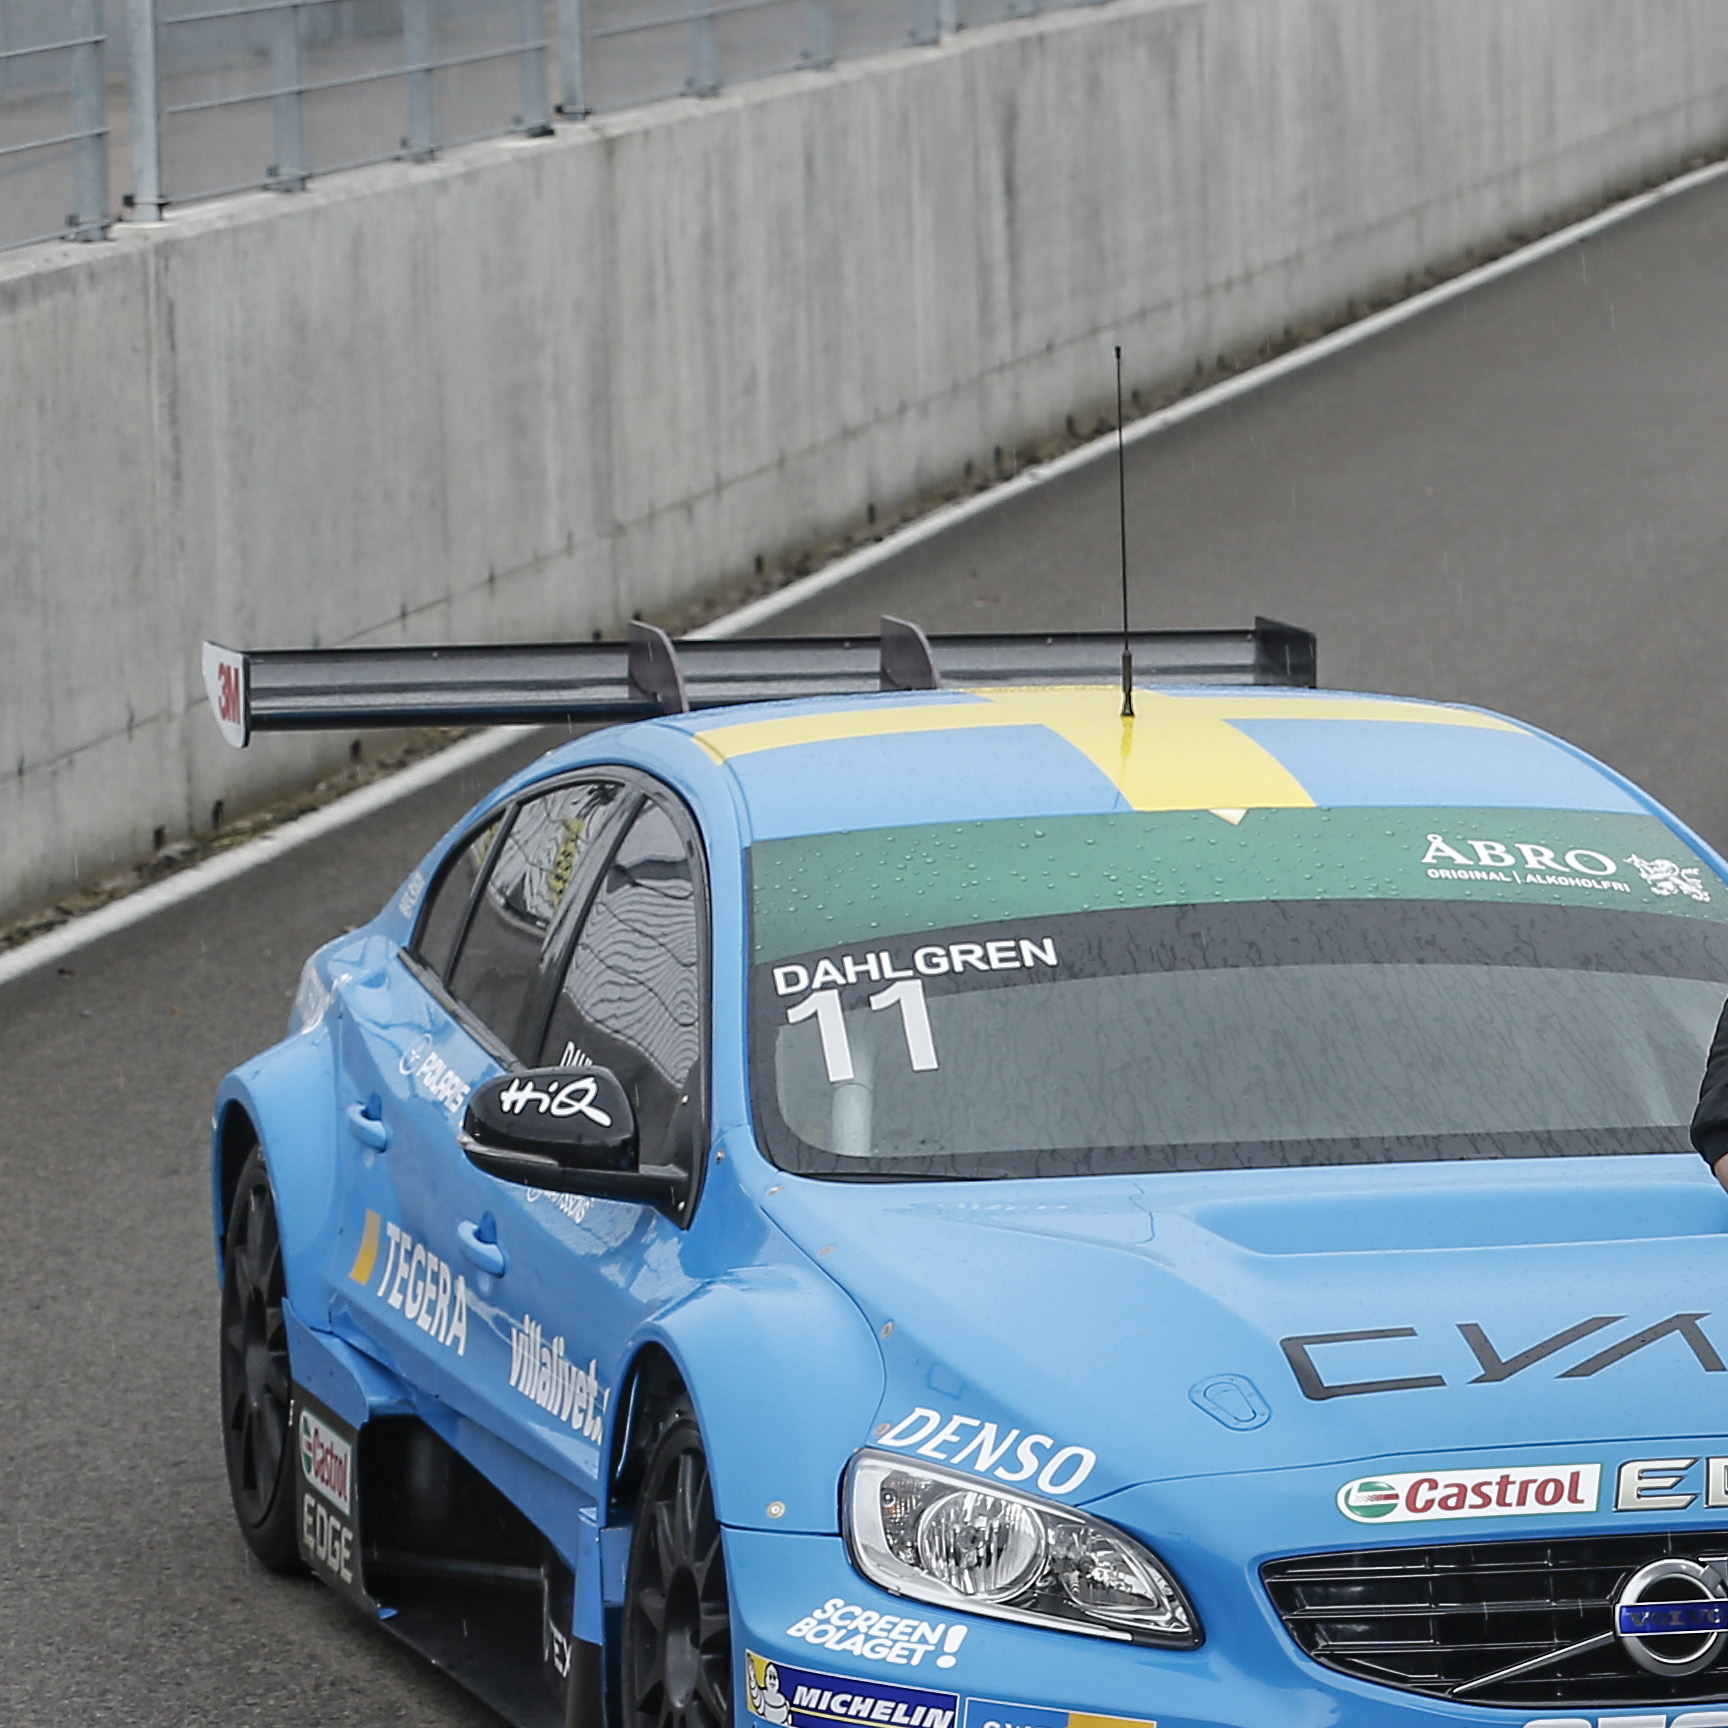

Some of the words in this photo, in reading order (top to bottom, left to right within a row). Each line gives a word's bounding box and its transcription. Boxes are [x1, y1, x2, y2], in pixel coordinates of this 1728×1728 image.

[219, 661, 241, 725] 3M
[1421, 833, 1617, 876] ÅBRO
[1427, 868, 1512, 882] ORIGINAL
[1526, 873, 1631, 892] ALKOHOLFRI
[772, 937, 1060, 996] DAHLGREN
[786, 978, 939, 1083] 11
[416, 1051, 471, 1113] POLARIS
[500, 1075, 613, 1128] HiQ
[376, 1220, 468, 1358] TEGERA
[876, 1406, 1098, 1496] DENSO
[1403, 1470, 1586, 1516] Castrol
[303, 1492, 355, 1585] EDGE
[812, 1597, 946, 1646] SCREEN
[1625, 1608, 1725, 1628] VOLVO
